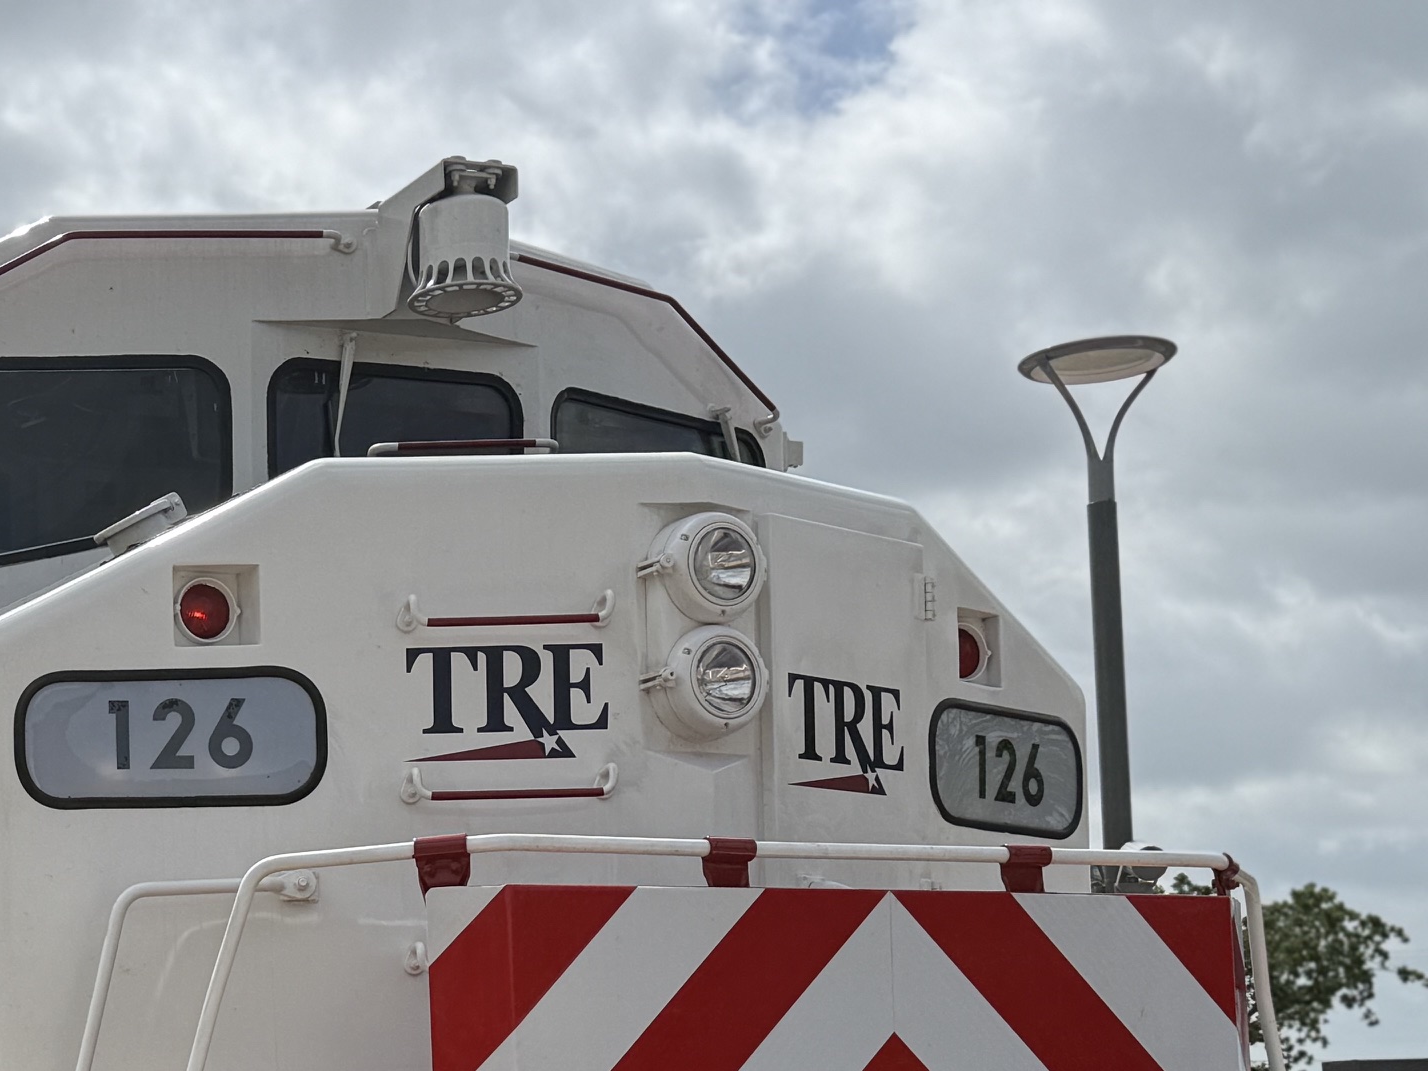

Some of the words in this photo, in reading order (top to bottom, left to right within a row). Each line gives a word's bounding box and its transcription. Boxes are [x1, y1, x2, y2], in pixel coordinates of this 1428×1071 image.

[108, 698, 253, 769] 126
[406, 643, 609, 757] TRE
[788, 673, 904, 795] TRE
[975, 734, 1044, 807] 126
